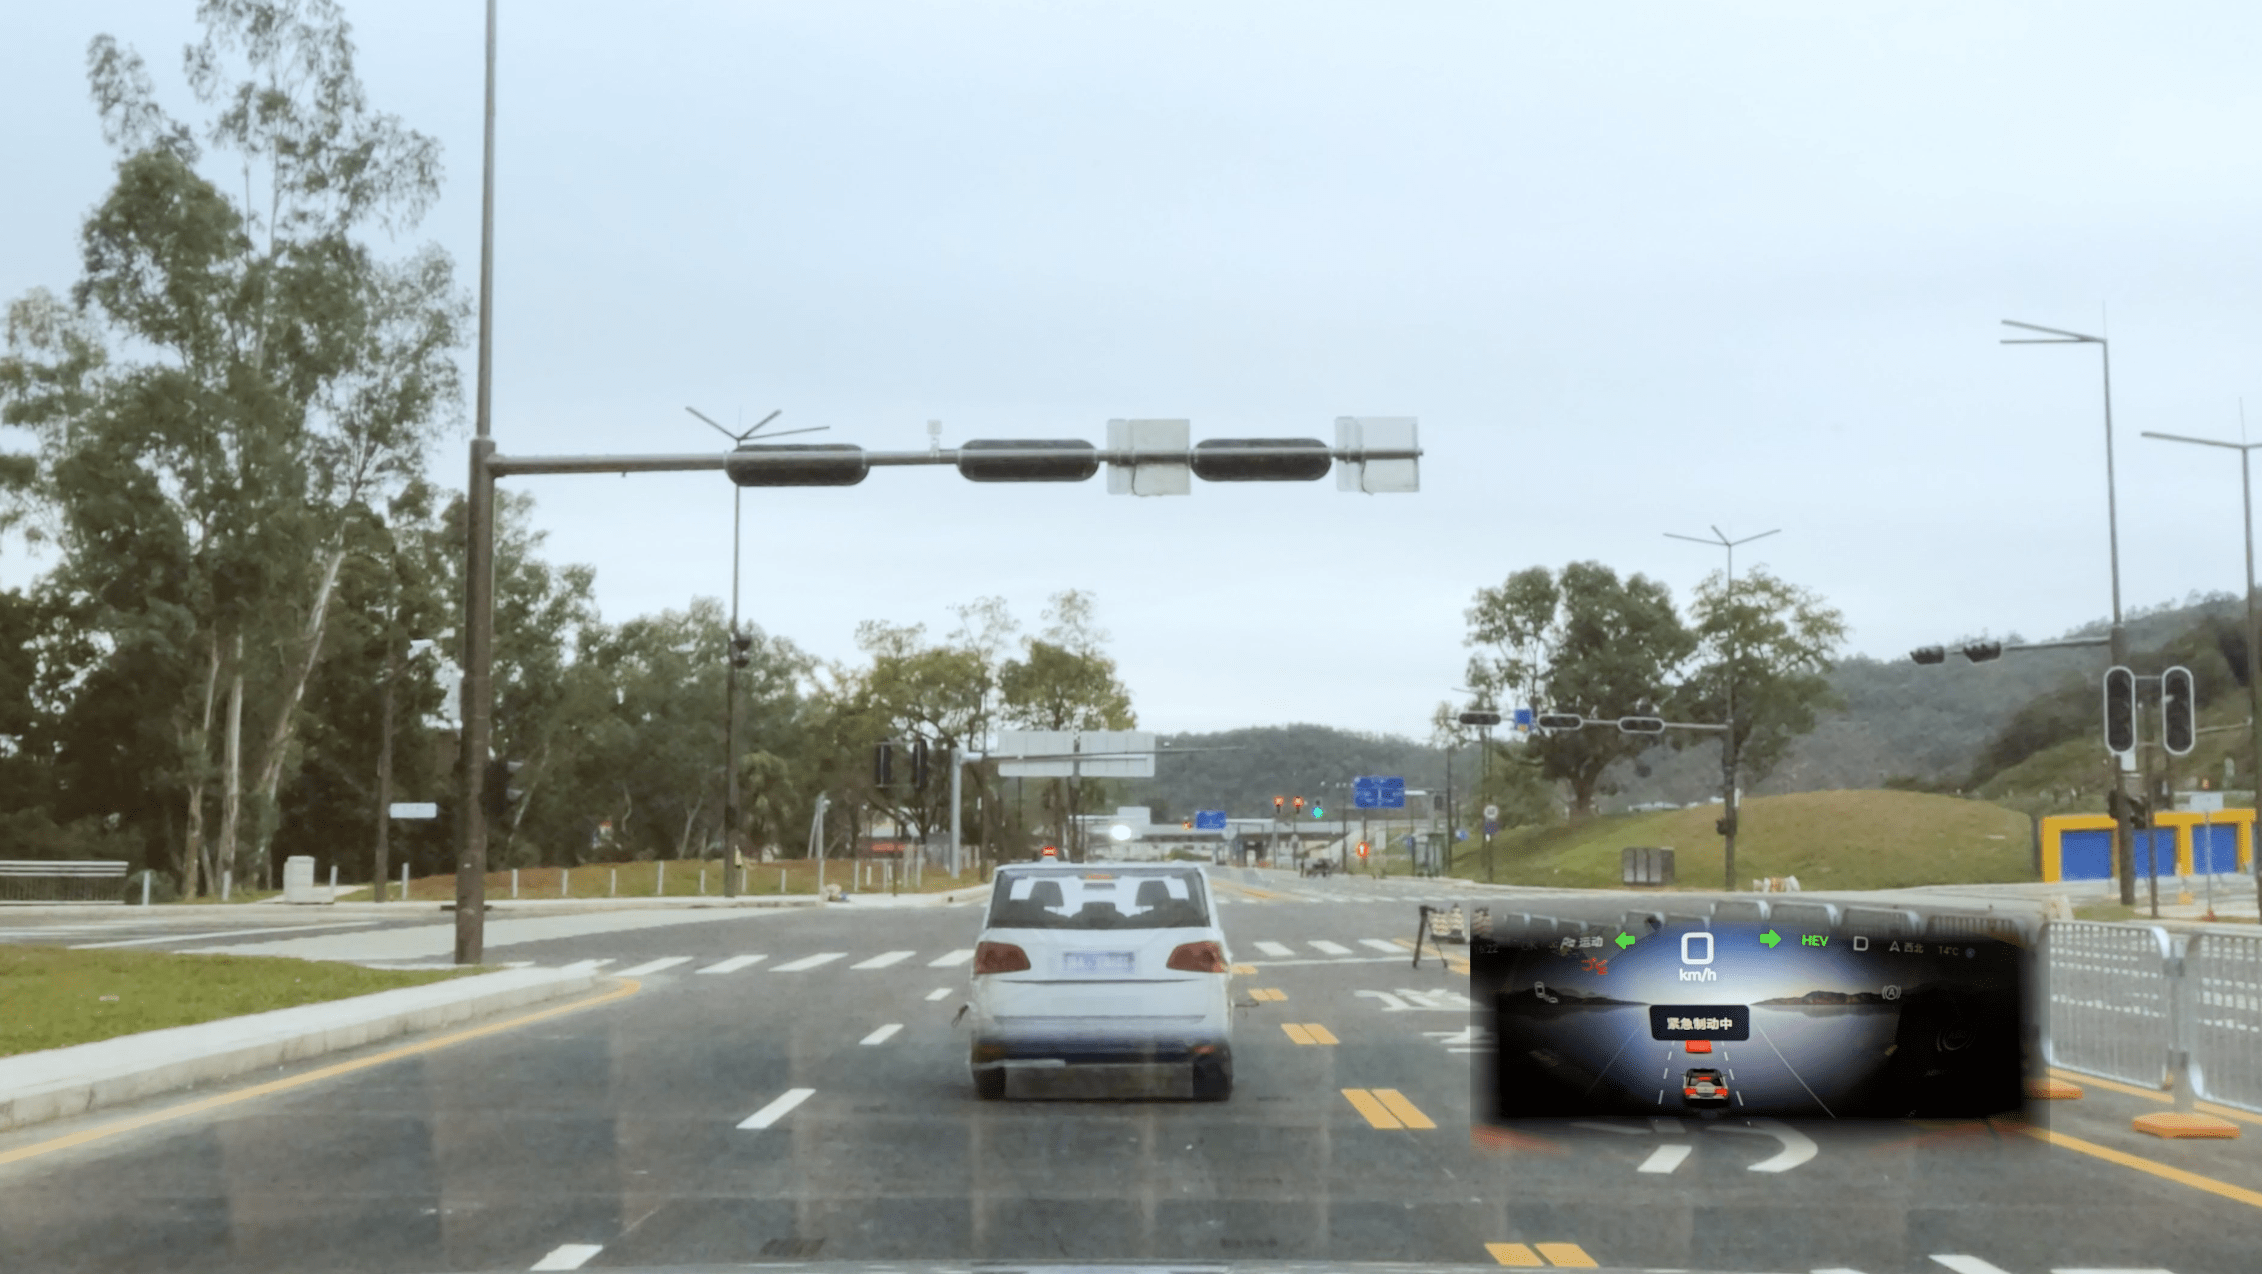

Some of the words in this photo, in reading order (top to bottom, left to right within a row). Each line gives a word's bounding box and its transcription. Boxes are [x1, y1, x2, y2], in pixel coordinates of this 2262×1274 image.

[1579, 936, 1603, 948] 运动
[1801, 935, 1829, 947] HEV
[1681, 932, 1714, 965] 0
[1679, 967, 1717, 983] km/h
[1667, 1017, 1733, 1031] 紧急制动中
